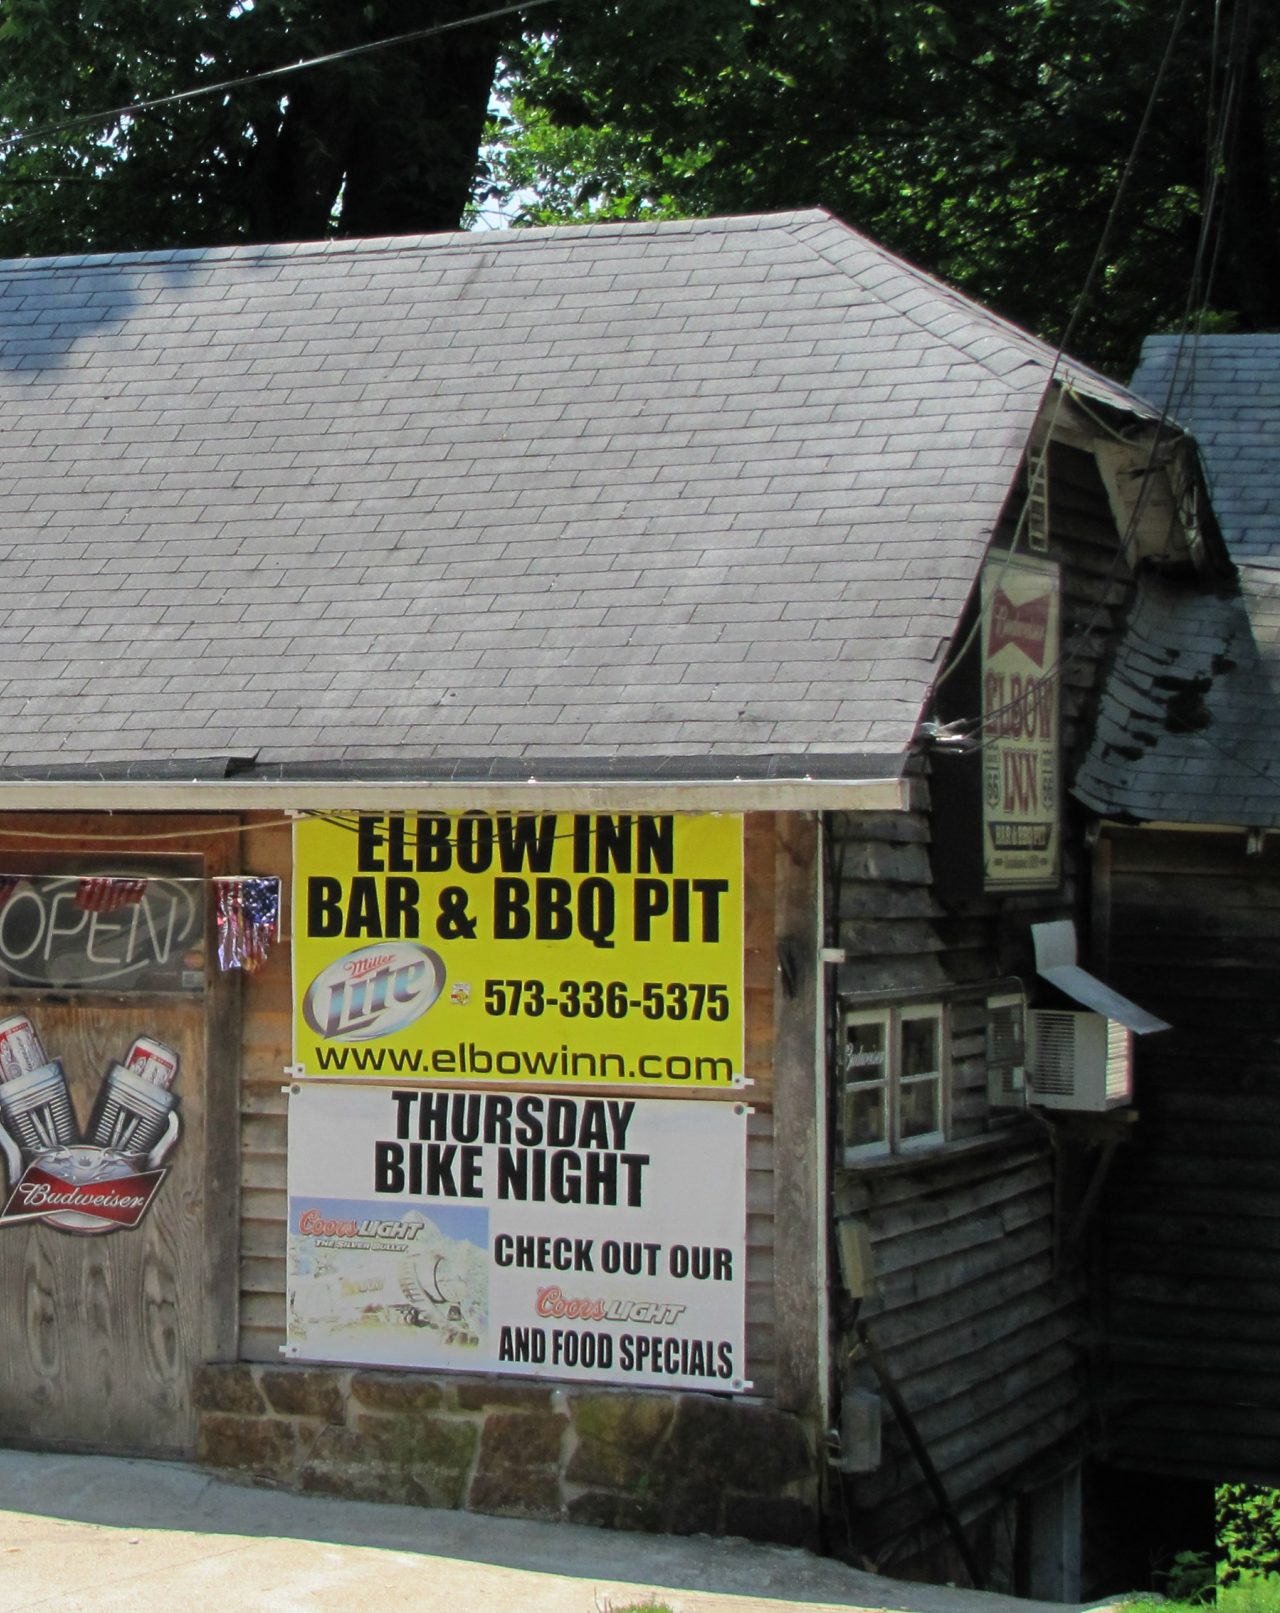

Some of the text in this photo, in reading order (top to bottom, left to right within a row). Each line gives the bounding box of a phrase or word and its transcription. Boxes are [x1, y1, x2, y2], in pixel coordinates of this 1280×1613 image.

[984, 672, 1053, 740] ELBOW
[1002, 748, 1038, 815] INN
[358, 809, 674, 874] ELBOW INN
[307, 876, 729, 948] BAR & BBQ PIT
[344, 954, 396, 978] Miller
[324, 960, 425, 1039] Lite
[485, 979, 729, 1021] 573-336-5375
[315, 1042, 732, 1081] www.elbowinn.com
[391, 1090, 635, 1150] THURSDAY
[19, 1182, 144, 1208] Budweiser
[375, 1140, 650, 1207] BIKE NIGHT
[299, 1208, 424, 1240] Coors LIGHT
[315, 1239, 408, 1252] THE SILVER BULLET
[494, 1233, 733, 1281] CHECK OUT OUR
[535, 1286, 686, 1325] Coors LIGHT
[498, 1326, 732, 1379] AND FOOD SPECIALS
